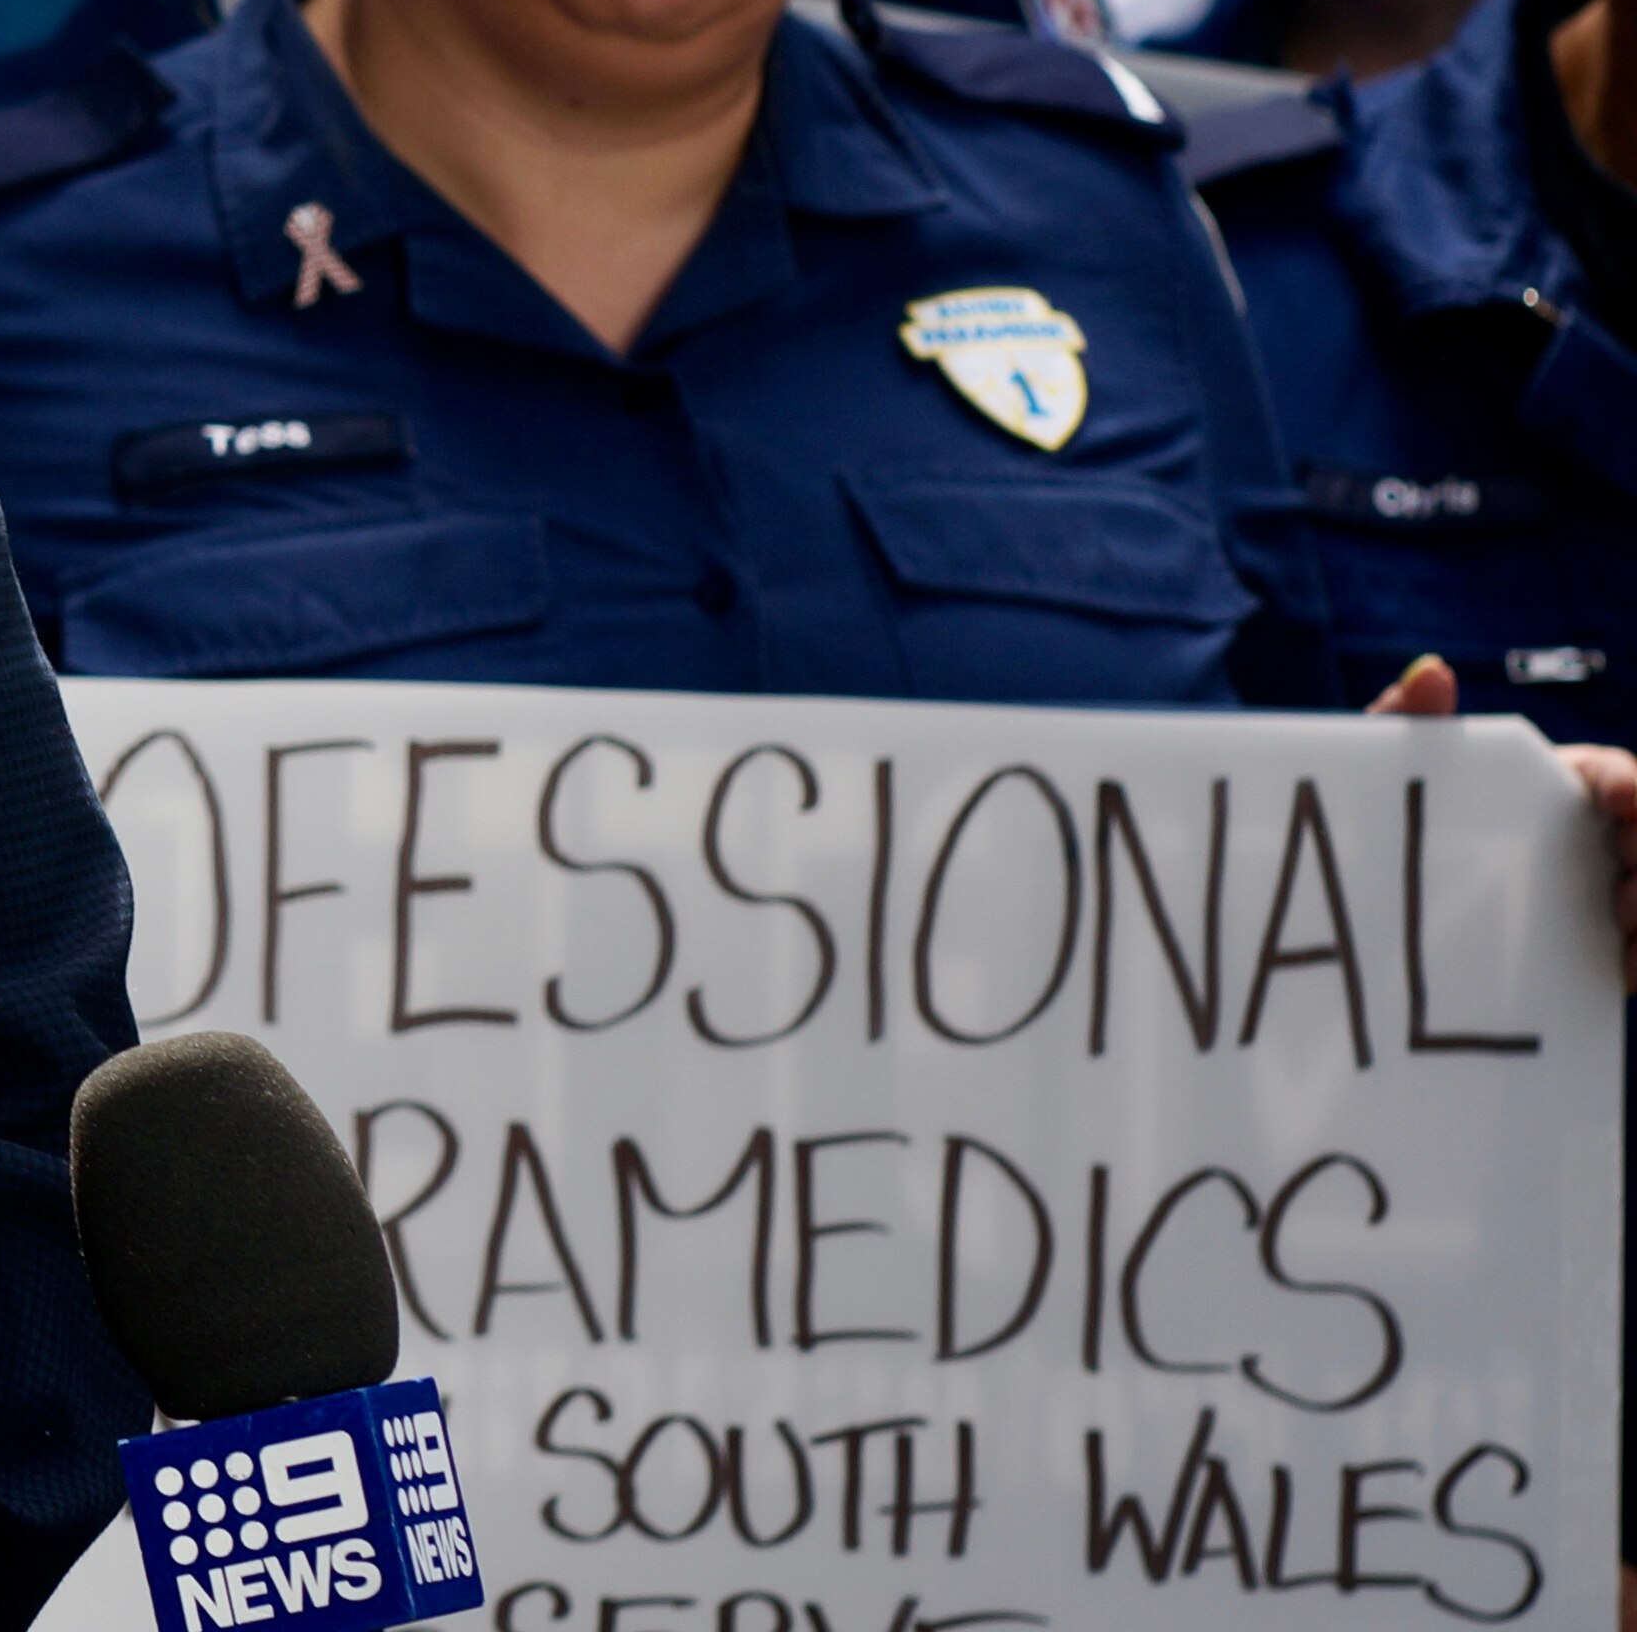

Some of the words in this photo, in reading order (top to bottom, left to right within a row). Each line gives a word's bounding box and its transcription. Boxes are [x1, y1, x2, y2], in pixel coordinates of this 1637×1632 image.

[353, 1099, 1406, 1411] RAMEDICS
[258, 1429, 370, 1544] 9
[533, 1385, 984, 1559] SOUTH
[1083, 1406, 1545, 1622] WALES
[176, 1537, 383, 1632] NEWS
[404, 1515, 474, 1586] NEWS
